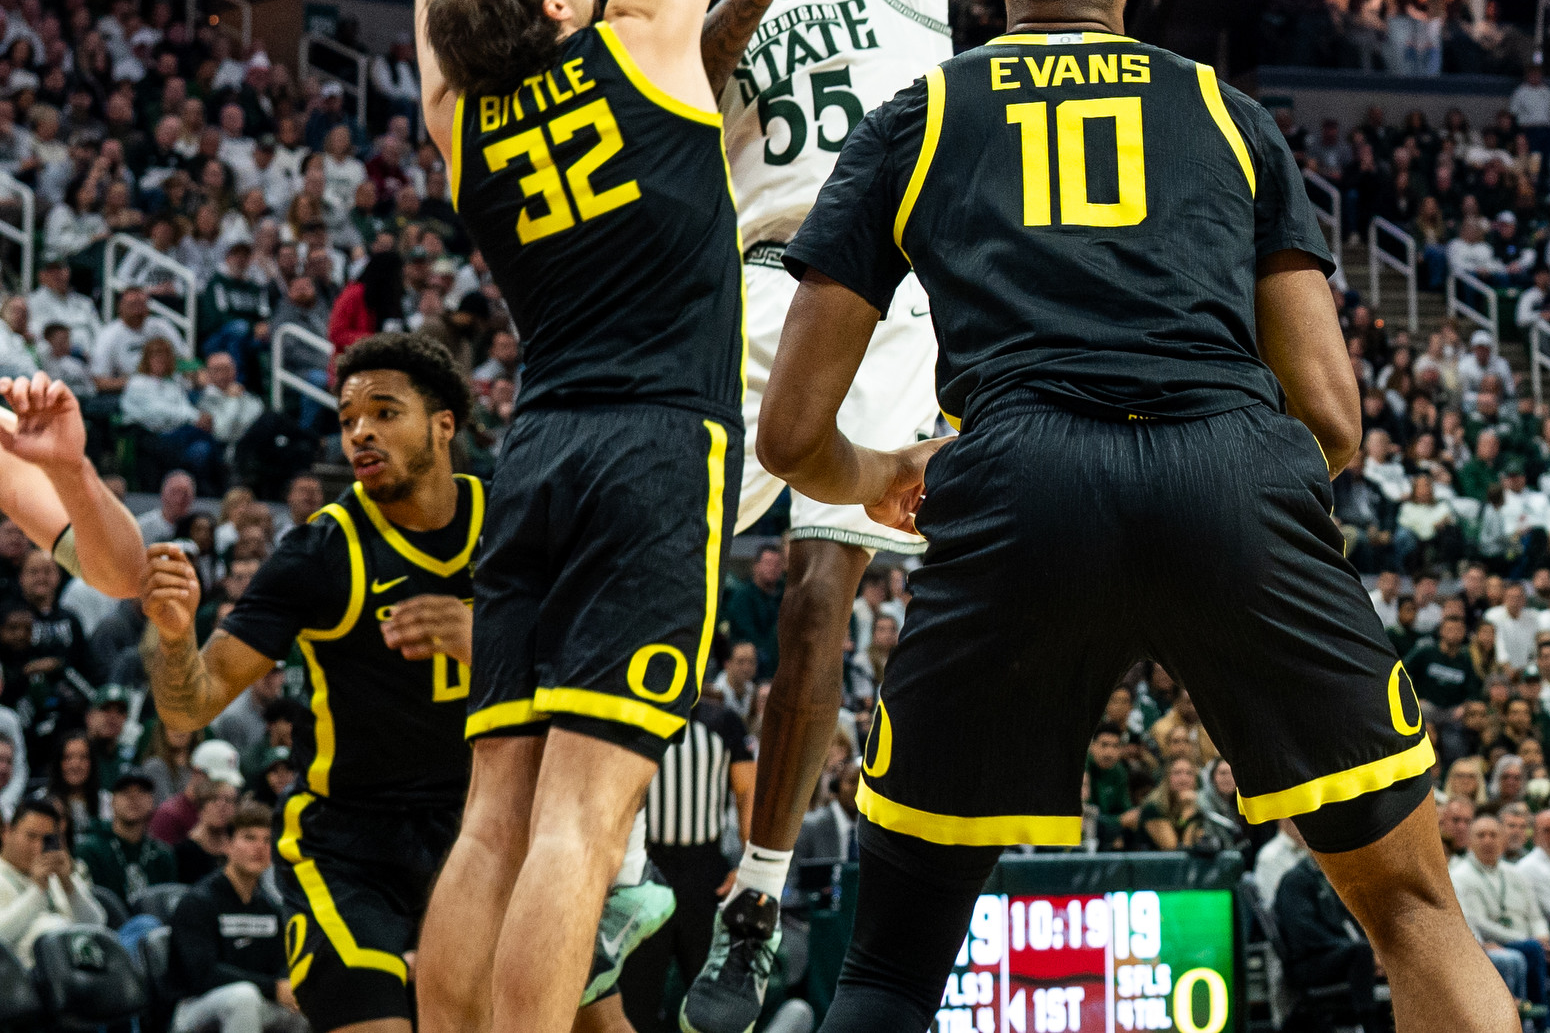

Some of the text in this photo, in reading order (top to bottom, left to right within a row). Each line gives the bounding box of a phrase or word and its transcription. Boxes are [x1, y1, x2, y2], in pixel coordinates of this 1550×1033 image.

[990, 53, 1152, 91] EVANS
[757, 65, 865, 166] 55
[482, 97, 643, 246] 32
[1006, 96, 1148, 228] 10
[1010, 898, 1110, 952] 10:19
[1113, 890, 1162, 960] 19
[1033, 986, 1085, 1033] 1ST
